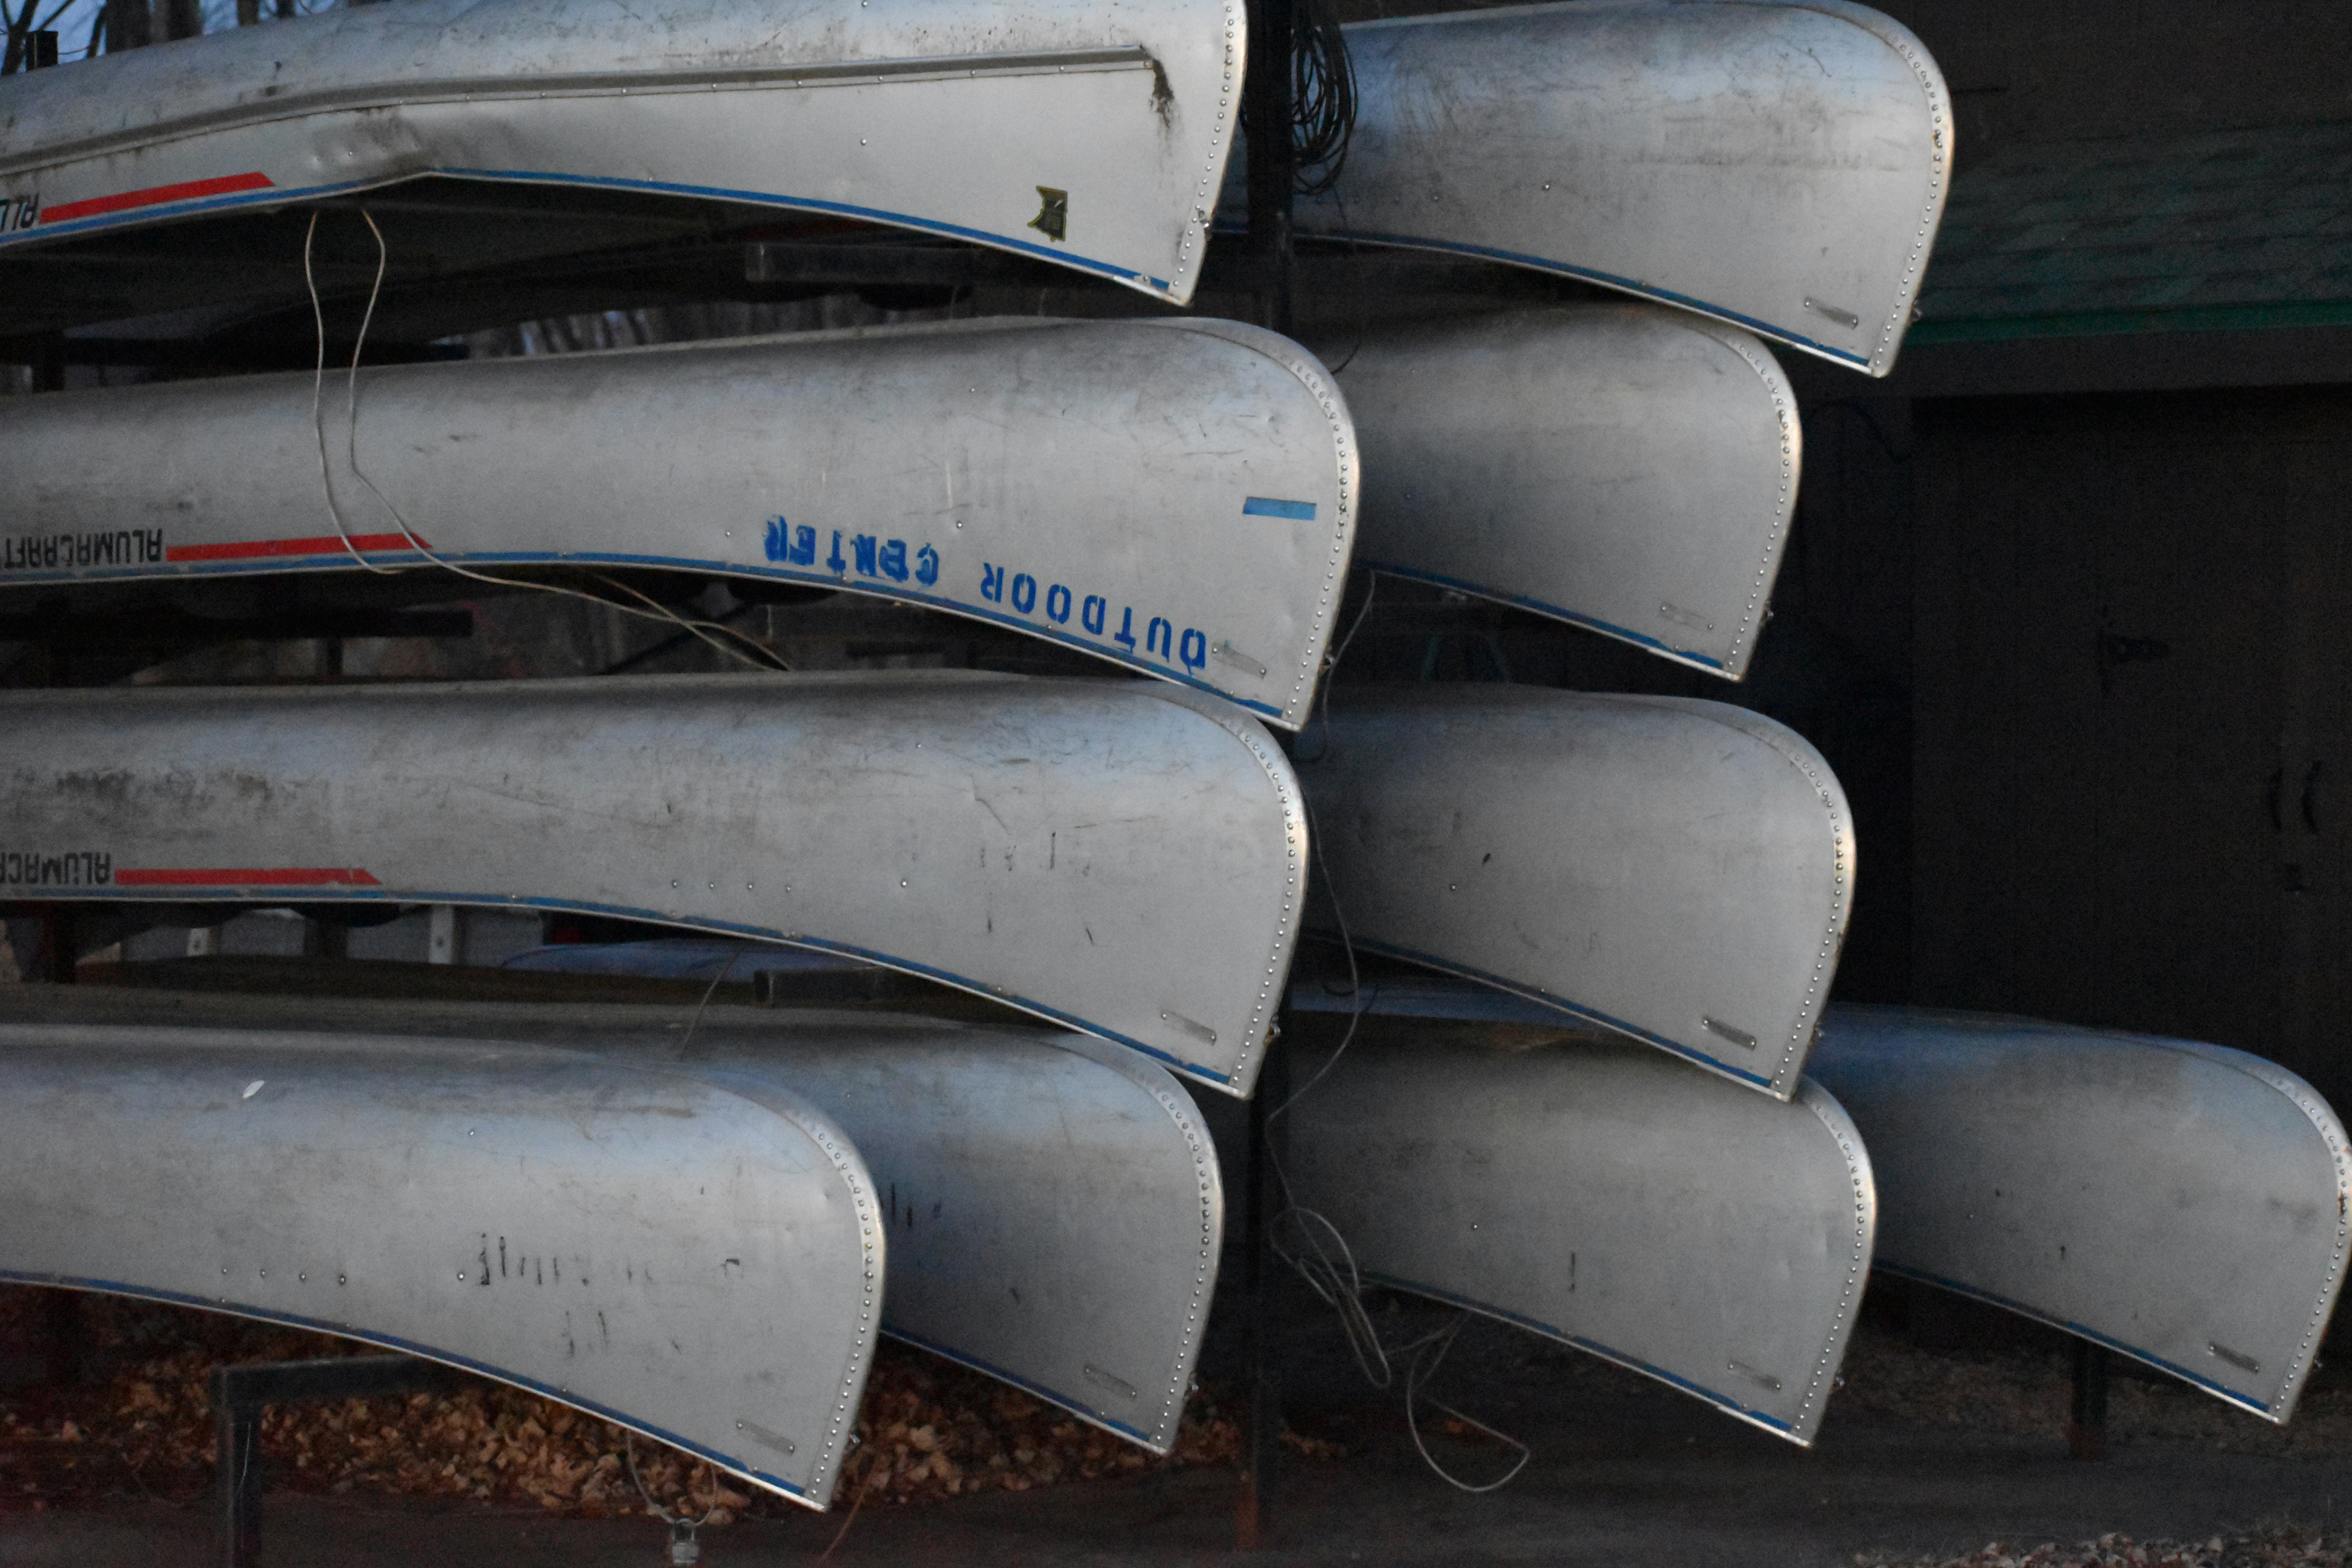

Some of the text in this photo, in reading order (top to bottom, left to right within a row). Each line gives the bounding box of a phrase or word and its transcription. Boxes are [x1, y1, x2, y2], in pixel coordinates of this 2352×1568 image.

[4, 528, 163, 569] ALUMACRAFT
[764, 515, 1206, 676] OUTDOOR CENTER
